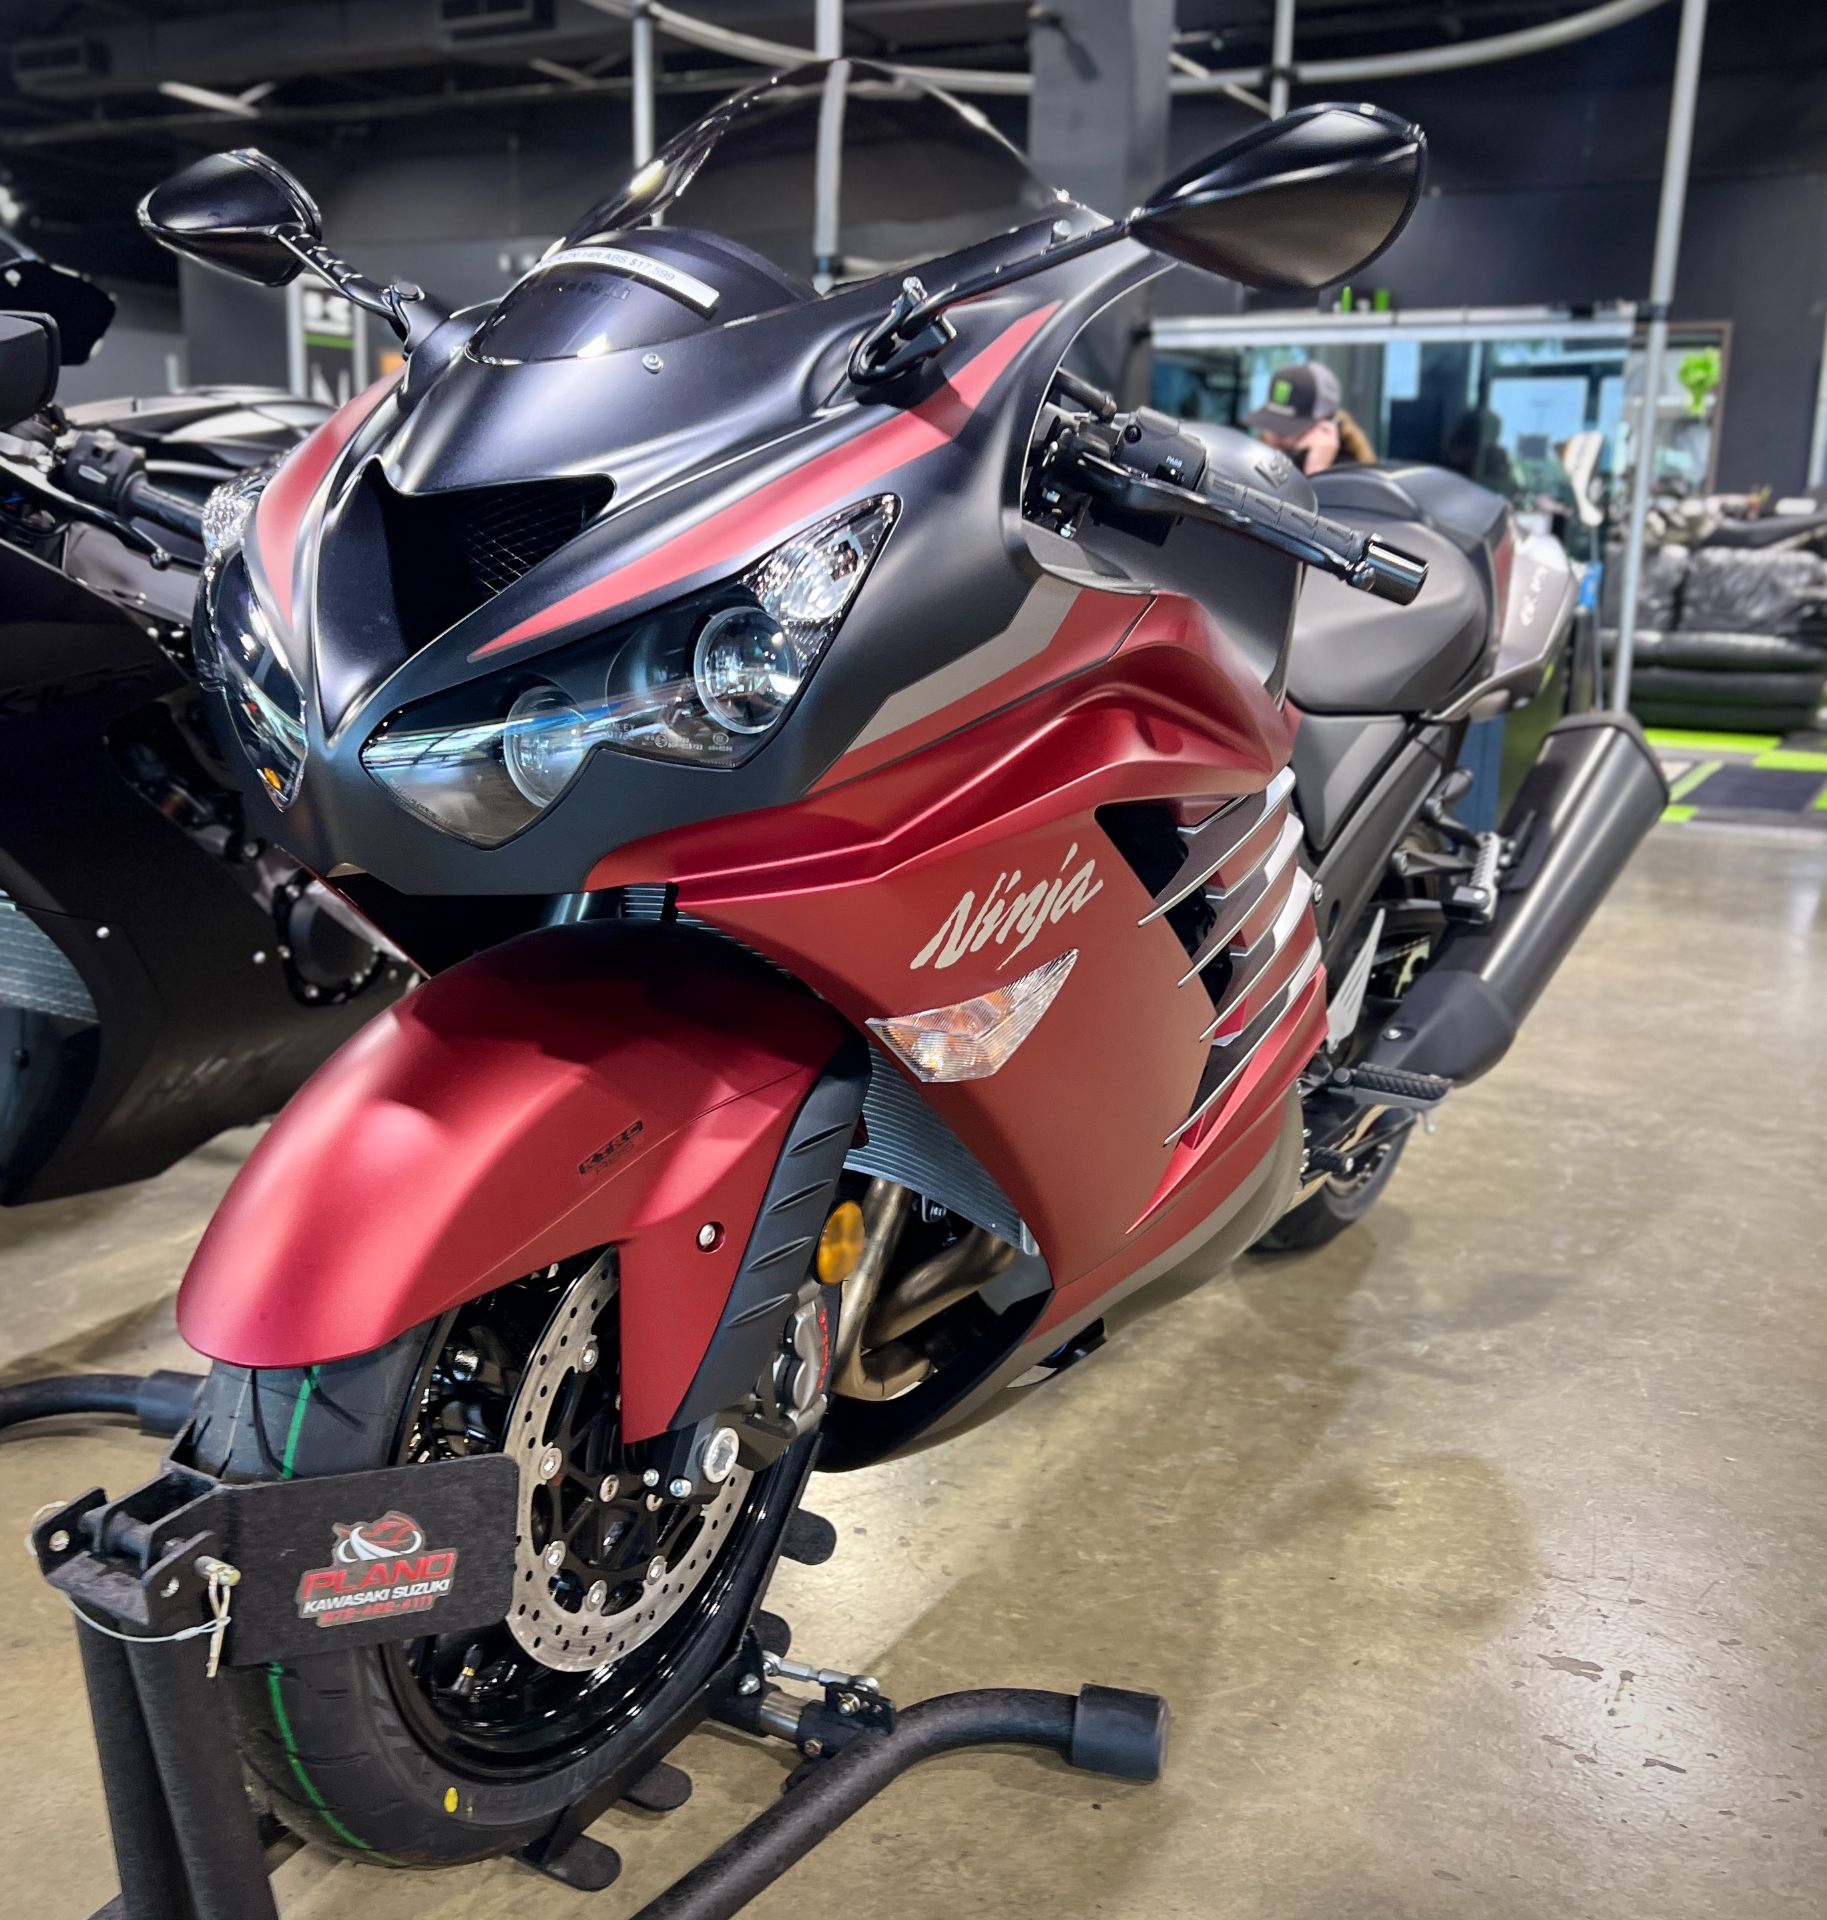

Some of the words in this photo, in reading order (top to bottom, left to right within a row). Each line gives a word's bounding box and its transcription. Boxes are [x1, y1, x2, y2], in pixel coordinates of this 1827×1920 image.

[604, 253, 629, 264] ABS
[629, 258, 677, 281] $17599
[909, 842, 1104, 971] Ninja
[303, 1552, 455, 1599] PLANO
[303, 1588, 391, 1614] KAWASAKI
[392, 1578, 451, 1600] SUZUKI
